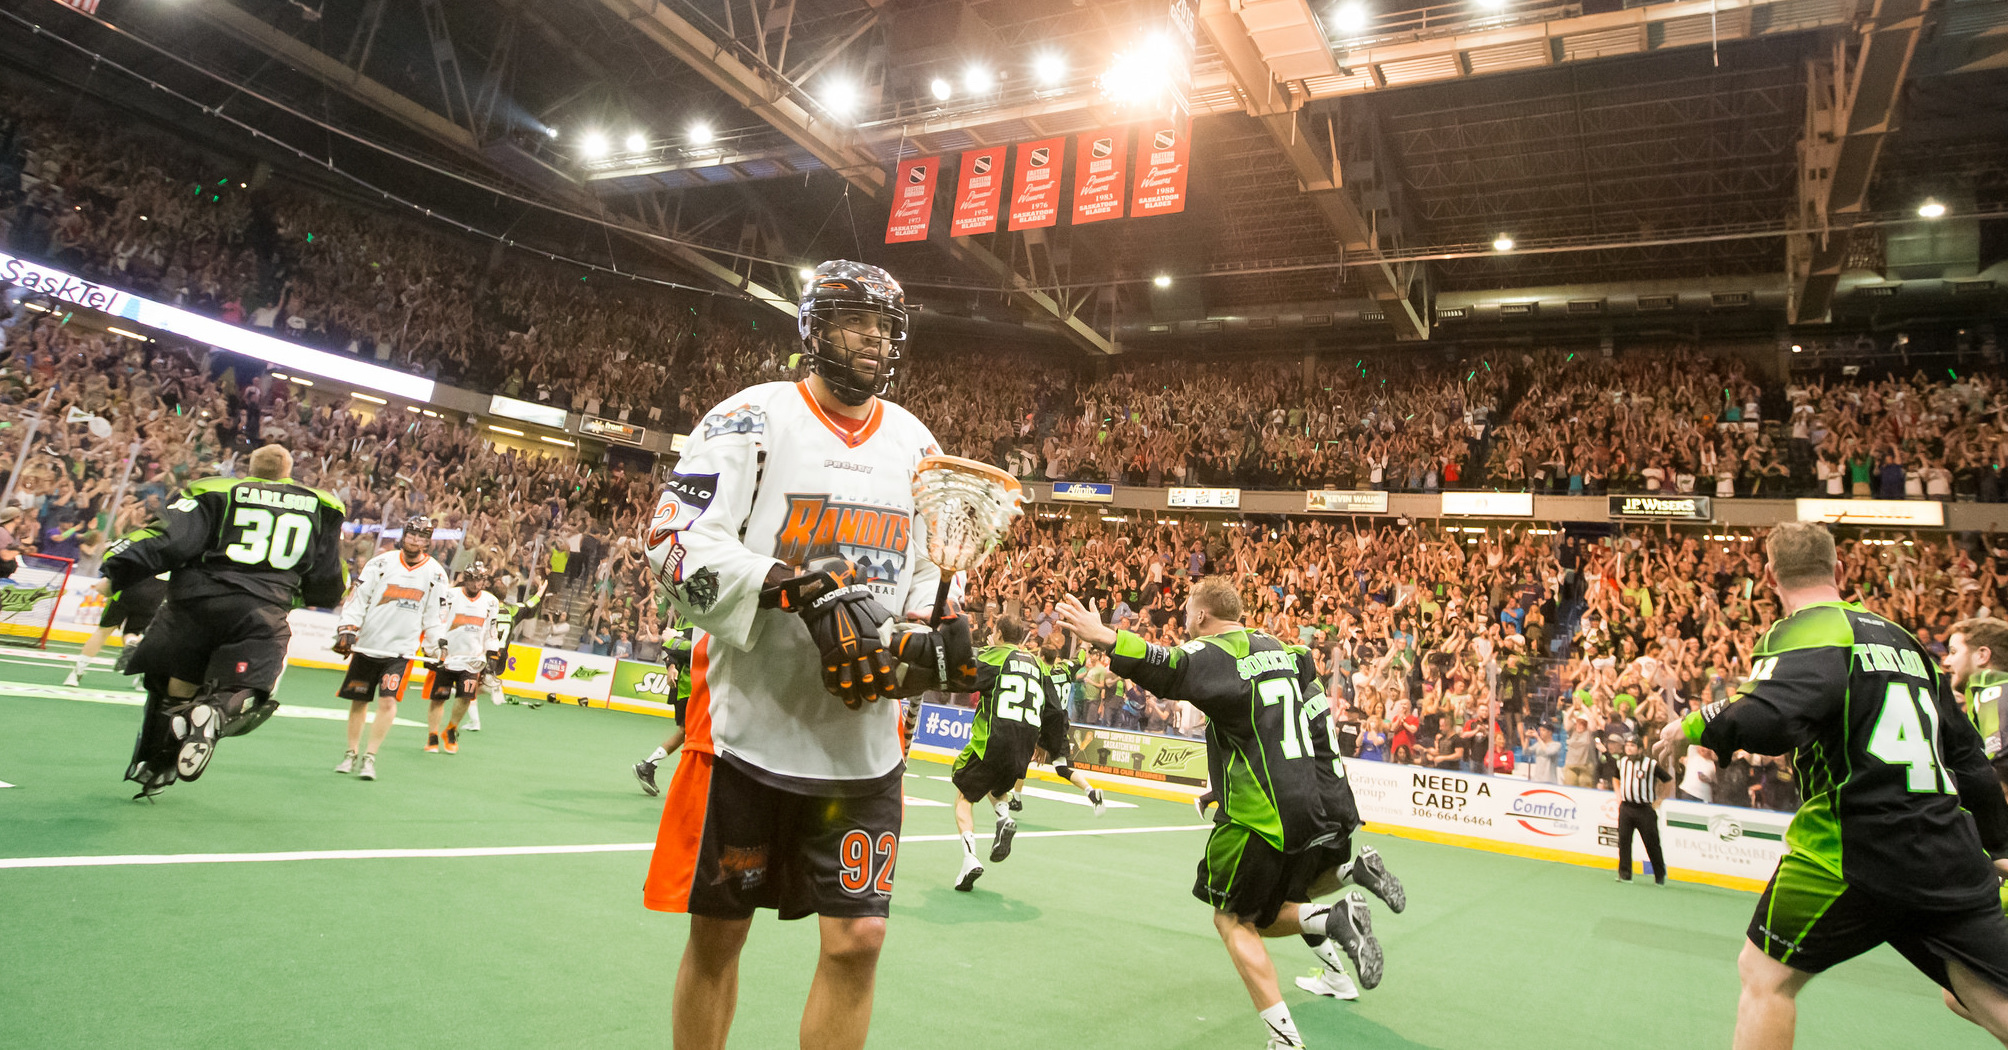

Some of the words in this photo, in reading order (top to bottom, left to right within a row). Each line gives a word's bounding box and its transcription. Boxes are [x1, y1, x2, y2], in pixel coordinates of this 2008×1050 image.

[1095, 193, 1113, 202] 1983
[1138, 193, 1179, 204] SASKATOON
[1156, 186, 1175, 195] 1988
[1013, 208, 1054, 219] SASKATOON
[1031, 201, 1048, 210] 1976
[1079, 200, 1118, 211] SASKATOON
[1085, 207, 1111, 216] BLADES
[1144, 200, 1172, 209] BLADES
[890, 223, 926, 232] SASKATOON
[955, 215, 994, 225] SASKATOON
[961, 221, 986, 229] BLADES
[1019, 215, 1046, 223] BLADES
[3, 259, 118, 313] SaskTel
[1067, 484, 1098, 495] Affinity
[235, 486, 319, 513] CARLSON
[1326, 494, 1352, 504] KEVIN
[226, 507, 313, 570] 30
[775, 493, 910, 566] BANDITS
[812, 588, 851, 609] UNDER
[935, 645, 948, 684] UNDER
[463, 680, 477, 693] 17
[634, 672, 670, 697] SU
[997, 674, 1046, 728] 23
[1867, 682, 1958, 795] 41
[1111, 750, 1131, 763] RUSH
[1073, 762, 1091, 771] YOUR
[1091, 764, 1112, 774] IMAGE
[1112, 767, 1120, 775] IS
[1120, 768, 1135, 777] OUR
[1135, 770, 1167, 782] BUSINESS
[1349, 770, 1398, 788] Graycon
[1412, 773, 1468, 794] NEED
[1476, 782, 1491, 799] A
[1412, 791, 1467, 812] CAB?
[1513, 798, 1577, 820] Comfort
[1411, 807, 1493, 827] 306-664-6464
[1674, 838, 1779, 862] BEACHCOMBER
[839, 829, 897, 897] 92
